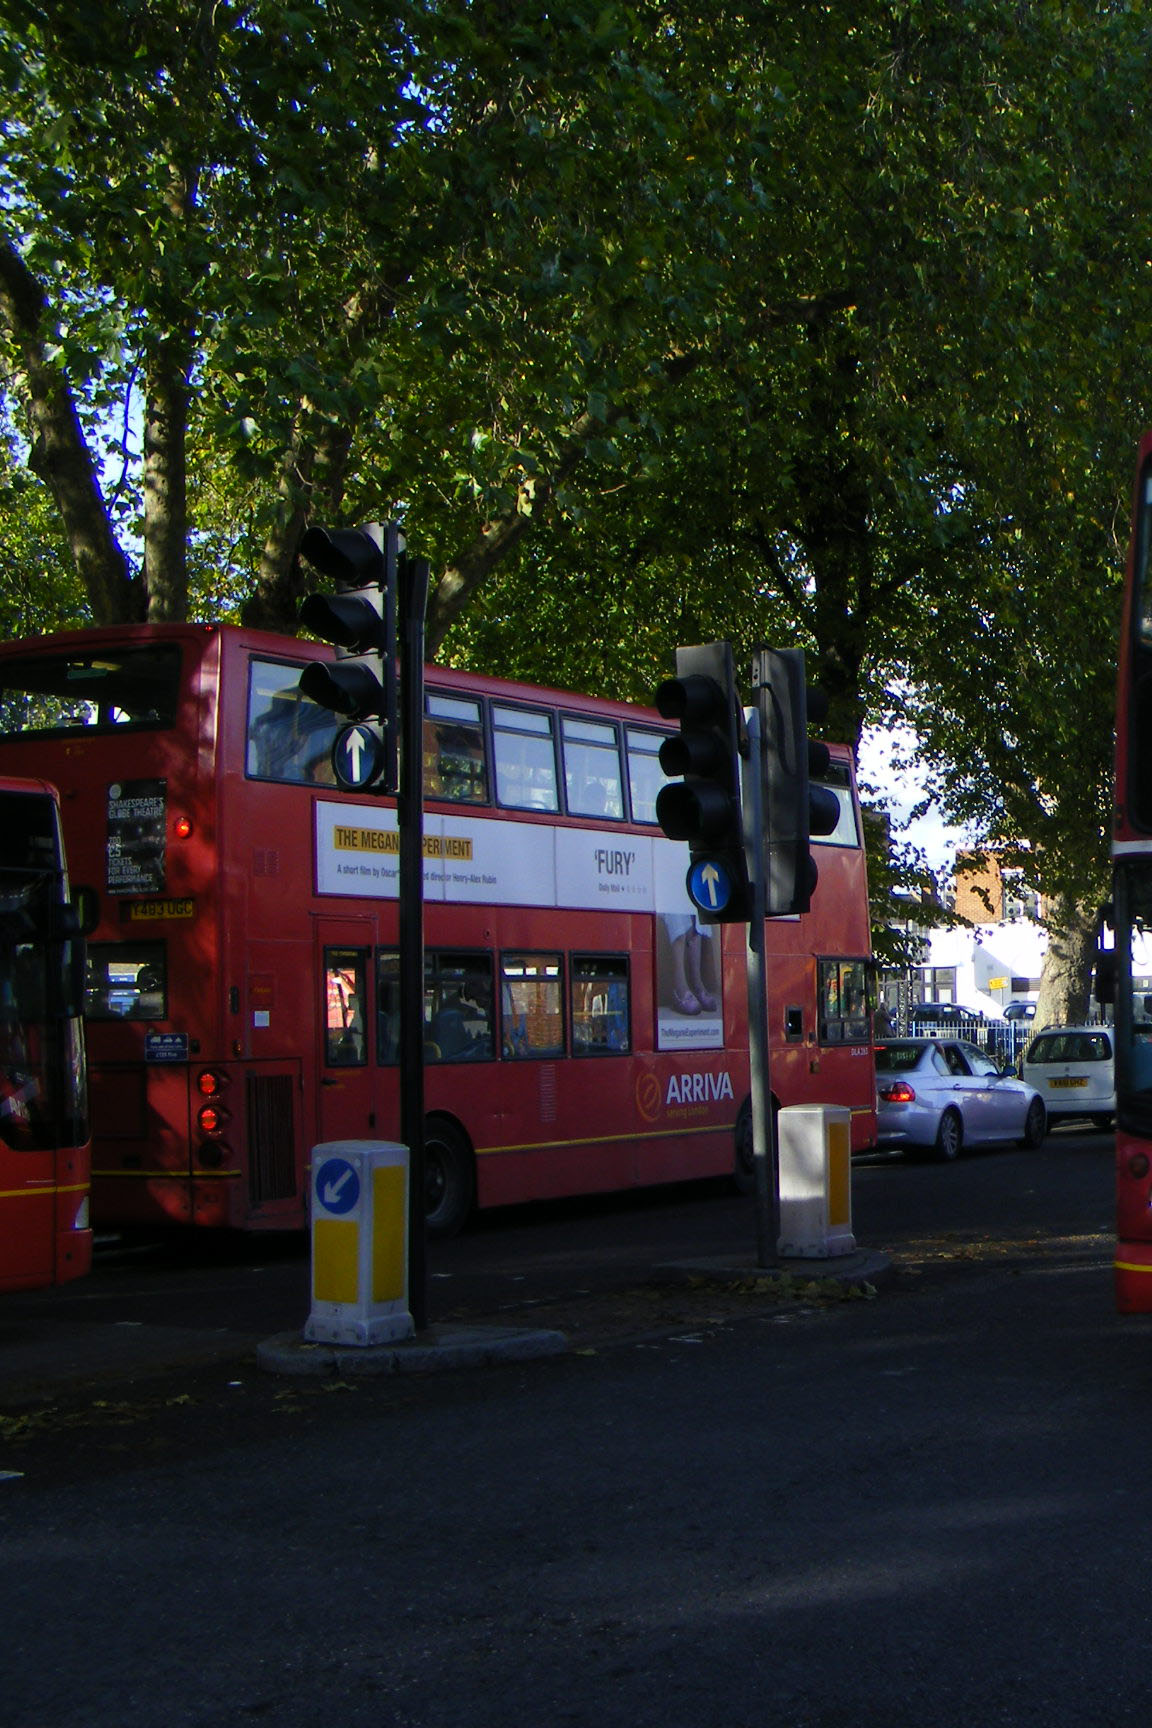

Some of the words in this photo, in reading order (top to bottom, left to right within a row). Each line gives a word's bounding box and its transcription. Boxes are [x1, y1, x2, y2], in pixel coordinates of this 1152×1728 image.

[133, 806, 164, 817] THEATRE
[336, 828, 358, 847] THE
[361, 830, 400, 851] MEGAN
[422, 837, 471, 857] PERIMENT
[336, 864, 342, 874] A
[343, 865, 358, 875] short
[359, 865, 371, 876] film
[372, 867, 380, 879] by
[431, 873, 451, 882] director
[482, 874, 497, 884] Rubin
[666, 1072, 734, 1105] ARRIVA
